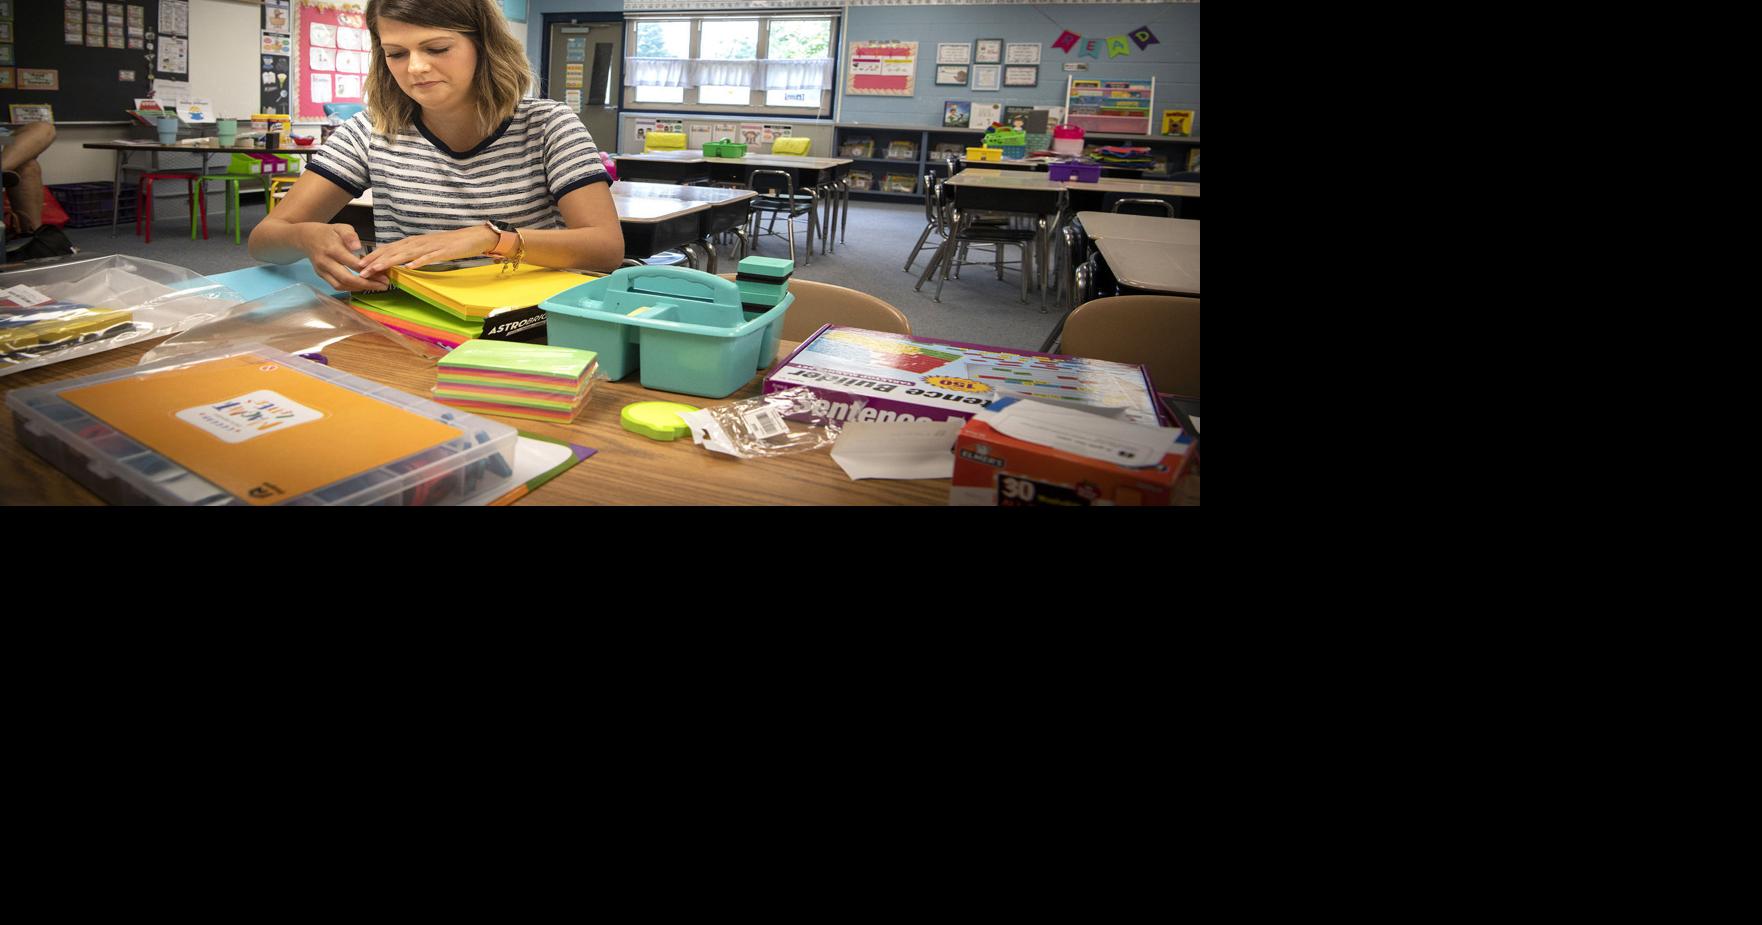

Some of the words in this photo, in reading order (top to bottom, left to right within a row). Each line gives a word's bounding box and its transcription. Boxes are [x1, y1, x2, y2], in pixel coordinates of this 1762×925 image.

[788, 370, 898, 392] Builder
[940, 379, 974, 389] 150
[1002, 477, 1035, 501] 30
